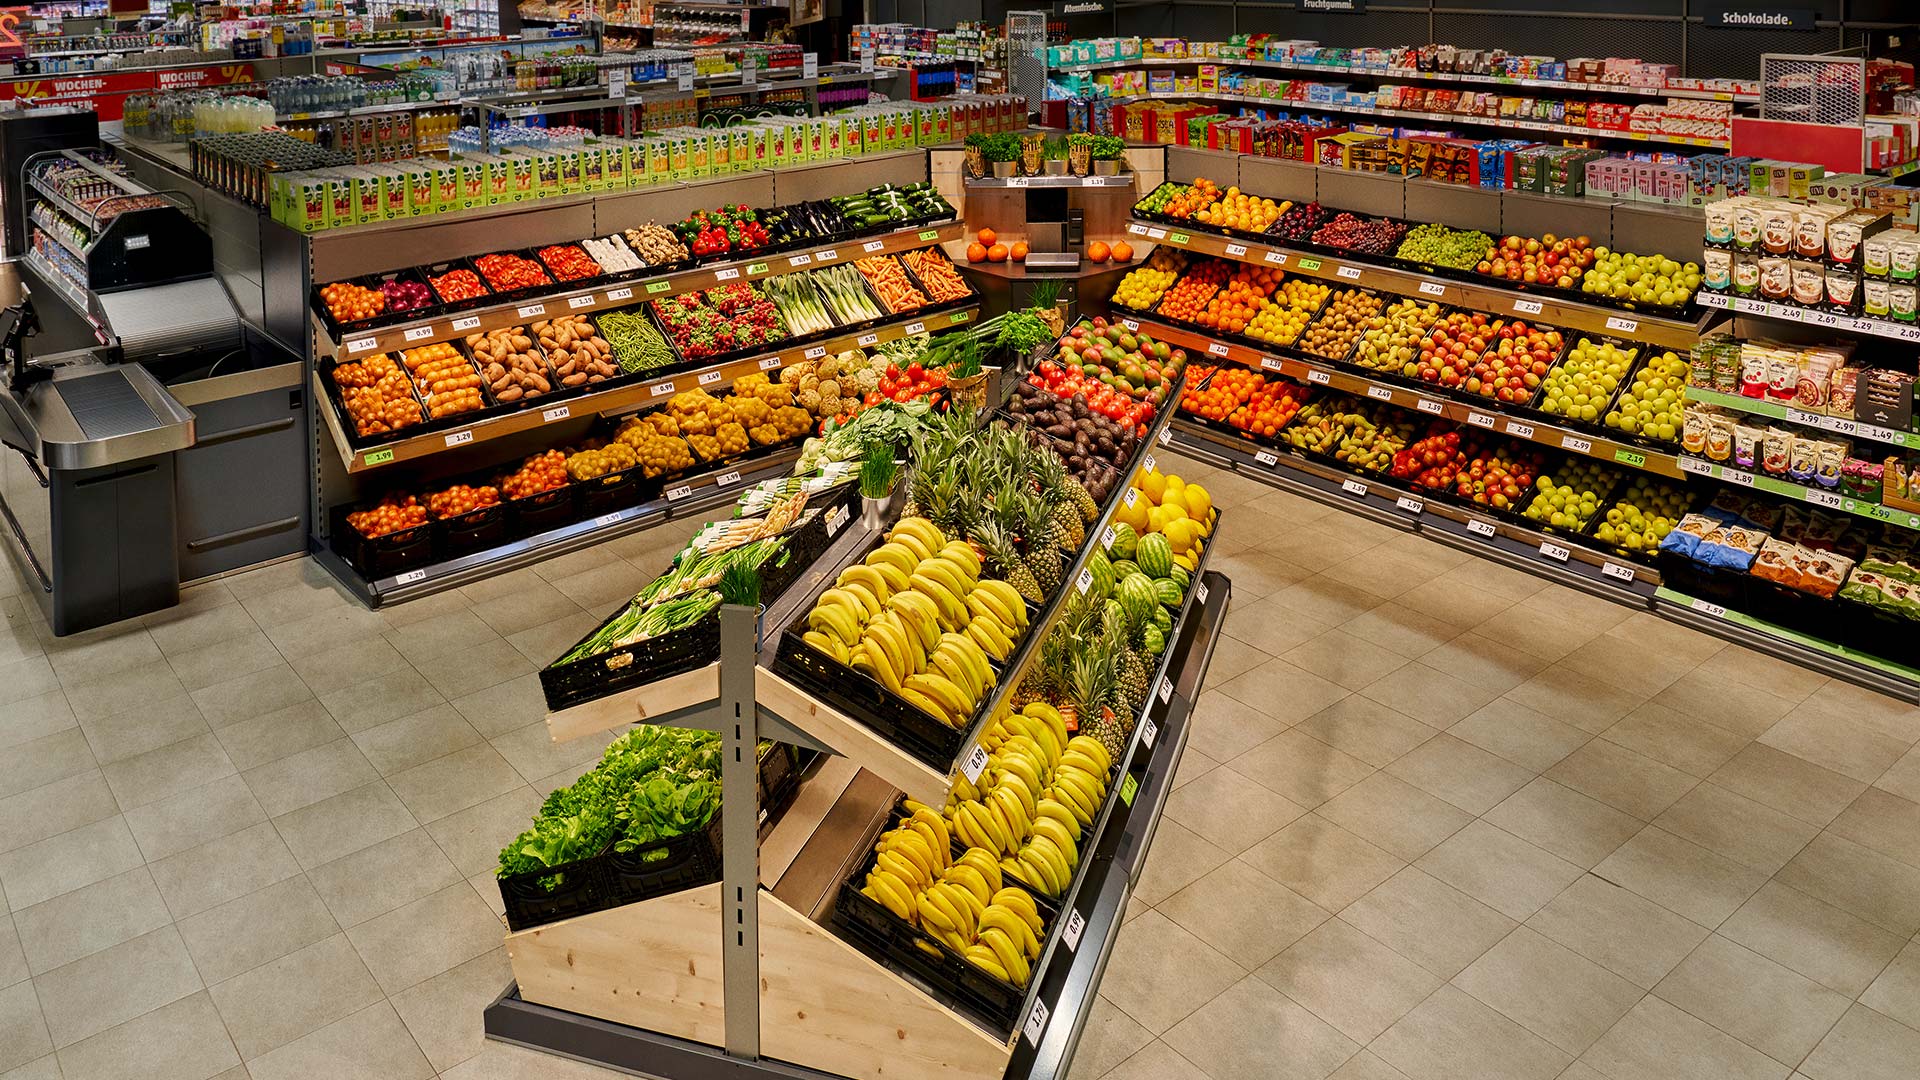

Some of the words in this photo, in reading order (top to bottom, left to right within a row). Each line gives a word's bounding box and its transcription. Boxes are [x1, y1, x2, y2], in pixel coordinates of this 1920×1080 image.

[1723, 12, 1793, 25] Schokolade.
[160, 71, 209, 83] WOCHEN-
[55, 79, 108, 92] WOCHEN-
[1710, 297, 1727, 306] 2.19
[1748, 302, 1766, 312] 2.39
[1782, 307, 1801, 317] 2.49
[464, 319, 478, 327] 0.99
[1817, 314, 1837, 324] 2.69
[1619, 322, 1635, 330] 1.99
[1854, 321, 1873, 331] 2.29
[416, 329, 431, 337] 0.99
[1900, 329, 1920, 340] 2.09
[360, 340, 374, 348] 1.49
[660, 384, 673, 392] 0.99
[554, 409, 568, 418] 1.69
[1800, 412, 1820, 424] 3.99
[1479, 417, 1493, 426] 2.19
[1835, 420, 1855, 432] 2.99
[1517, 426, 1532, 435] 2.59
[1872, 429, 1893, 441] 1.49
[456, 433, 471, 442] 1.29
[1574, 441, 1589, 450] 2.99
[376, 452, 392, 461] 1.99
[1627, 454, 1644, 464] 2.19
[1694, 462, 1711, 473] 1.89
[1735, 473, 1753, 484] 1.89
[1821, 494, 1840, 506] 1.99
[1407, 501, 1421, 510] 1.99
[1870, 507, 1891, 519] 2.99
[1478, 524, 1493, 533] 2.79
[1552, 548, 1568, 557] 2.99
[408, 572, 423, 580] 1.29
[1615, 568, 1632, 577] 3.29
[1706, 605, 1724, 615] 1.59
[972, 748, 985, 770] 0.99
[1070, 913, 1082, 935] 0.99
[1033, 1003, 1045, 1028] 1.79
